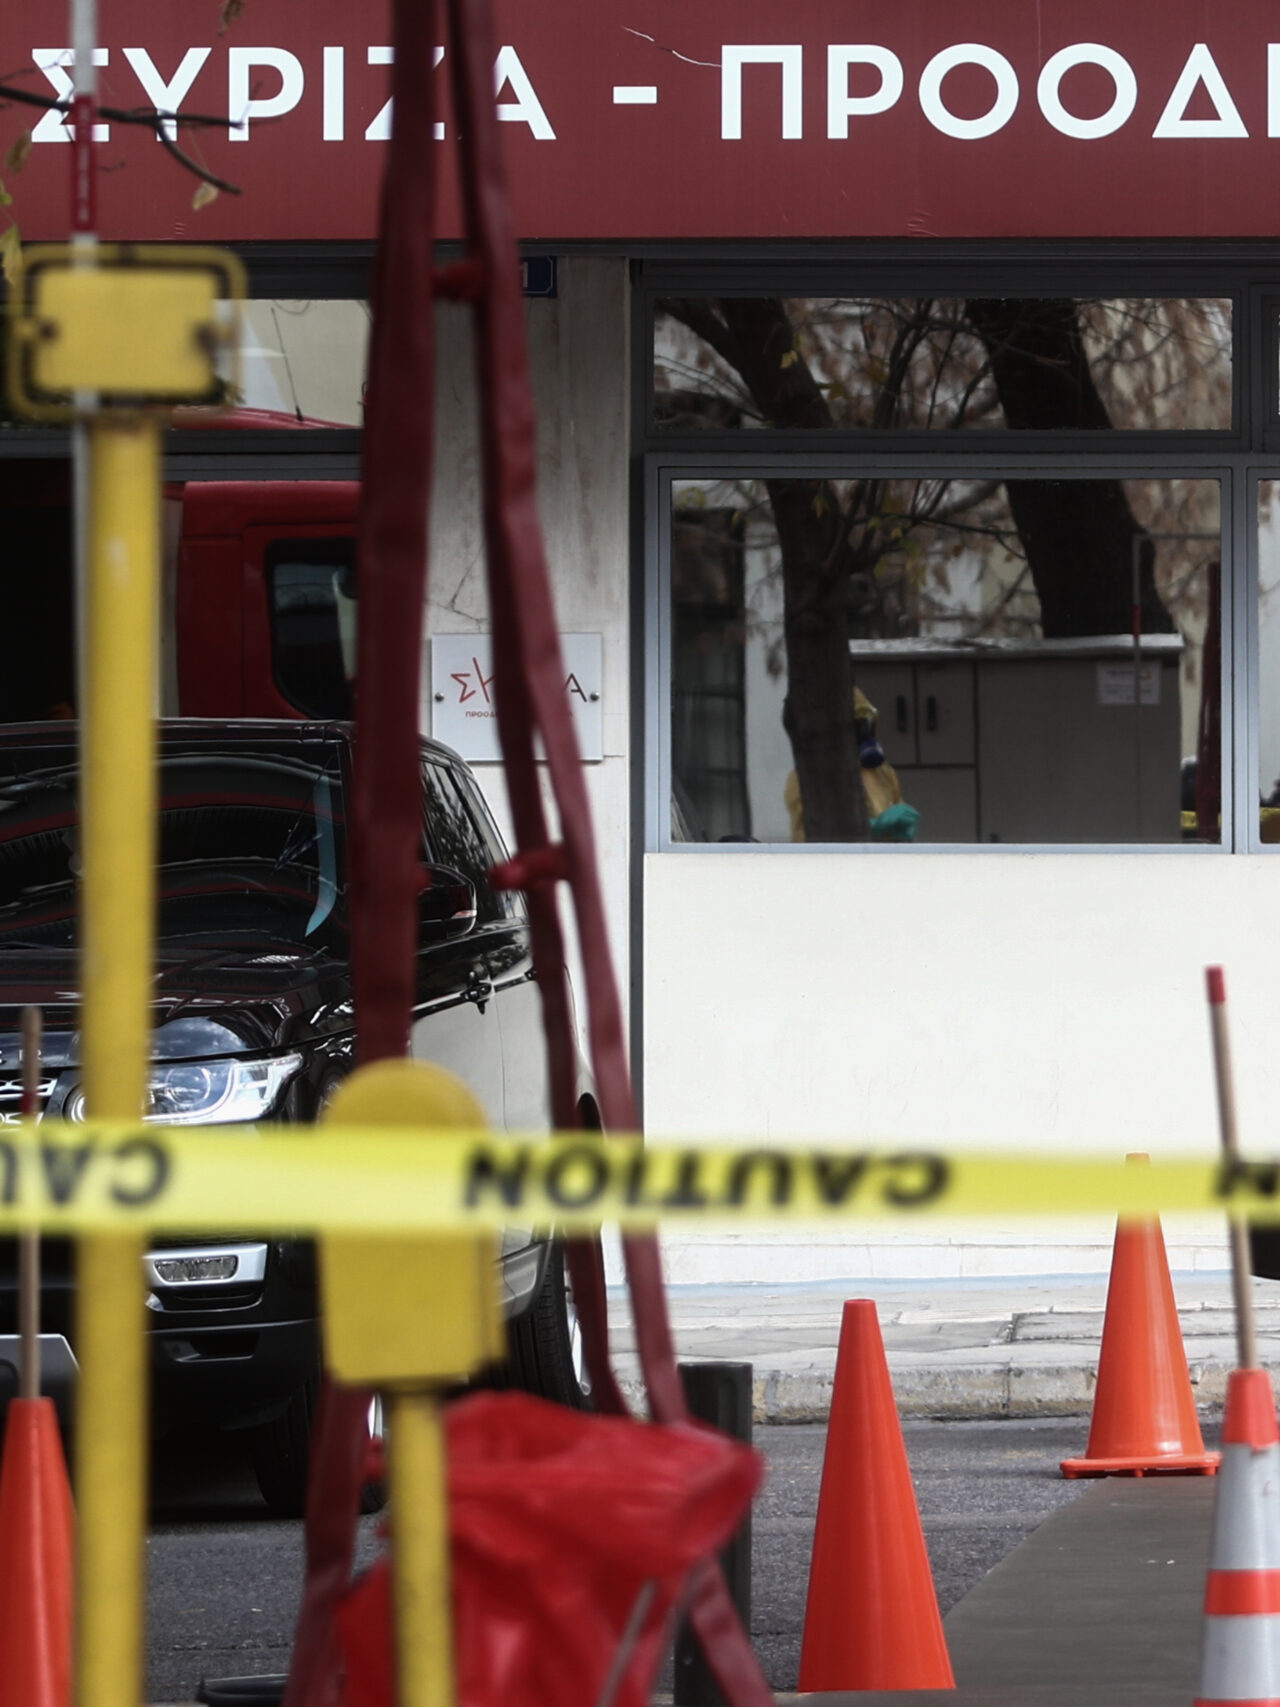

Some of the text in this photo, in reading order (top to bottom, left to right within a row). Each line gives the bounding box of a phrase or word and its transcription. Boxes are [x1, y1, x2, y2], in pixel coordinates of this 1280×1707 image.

[614, 87, 657, 103] -
[0, 1132, 172, 1207] CA
[463, 1139, 951, 1209] CAUTION
